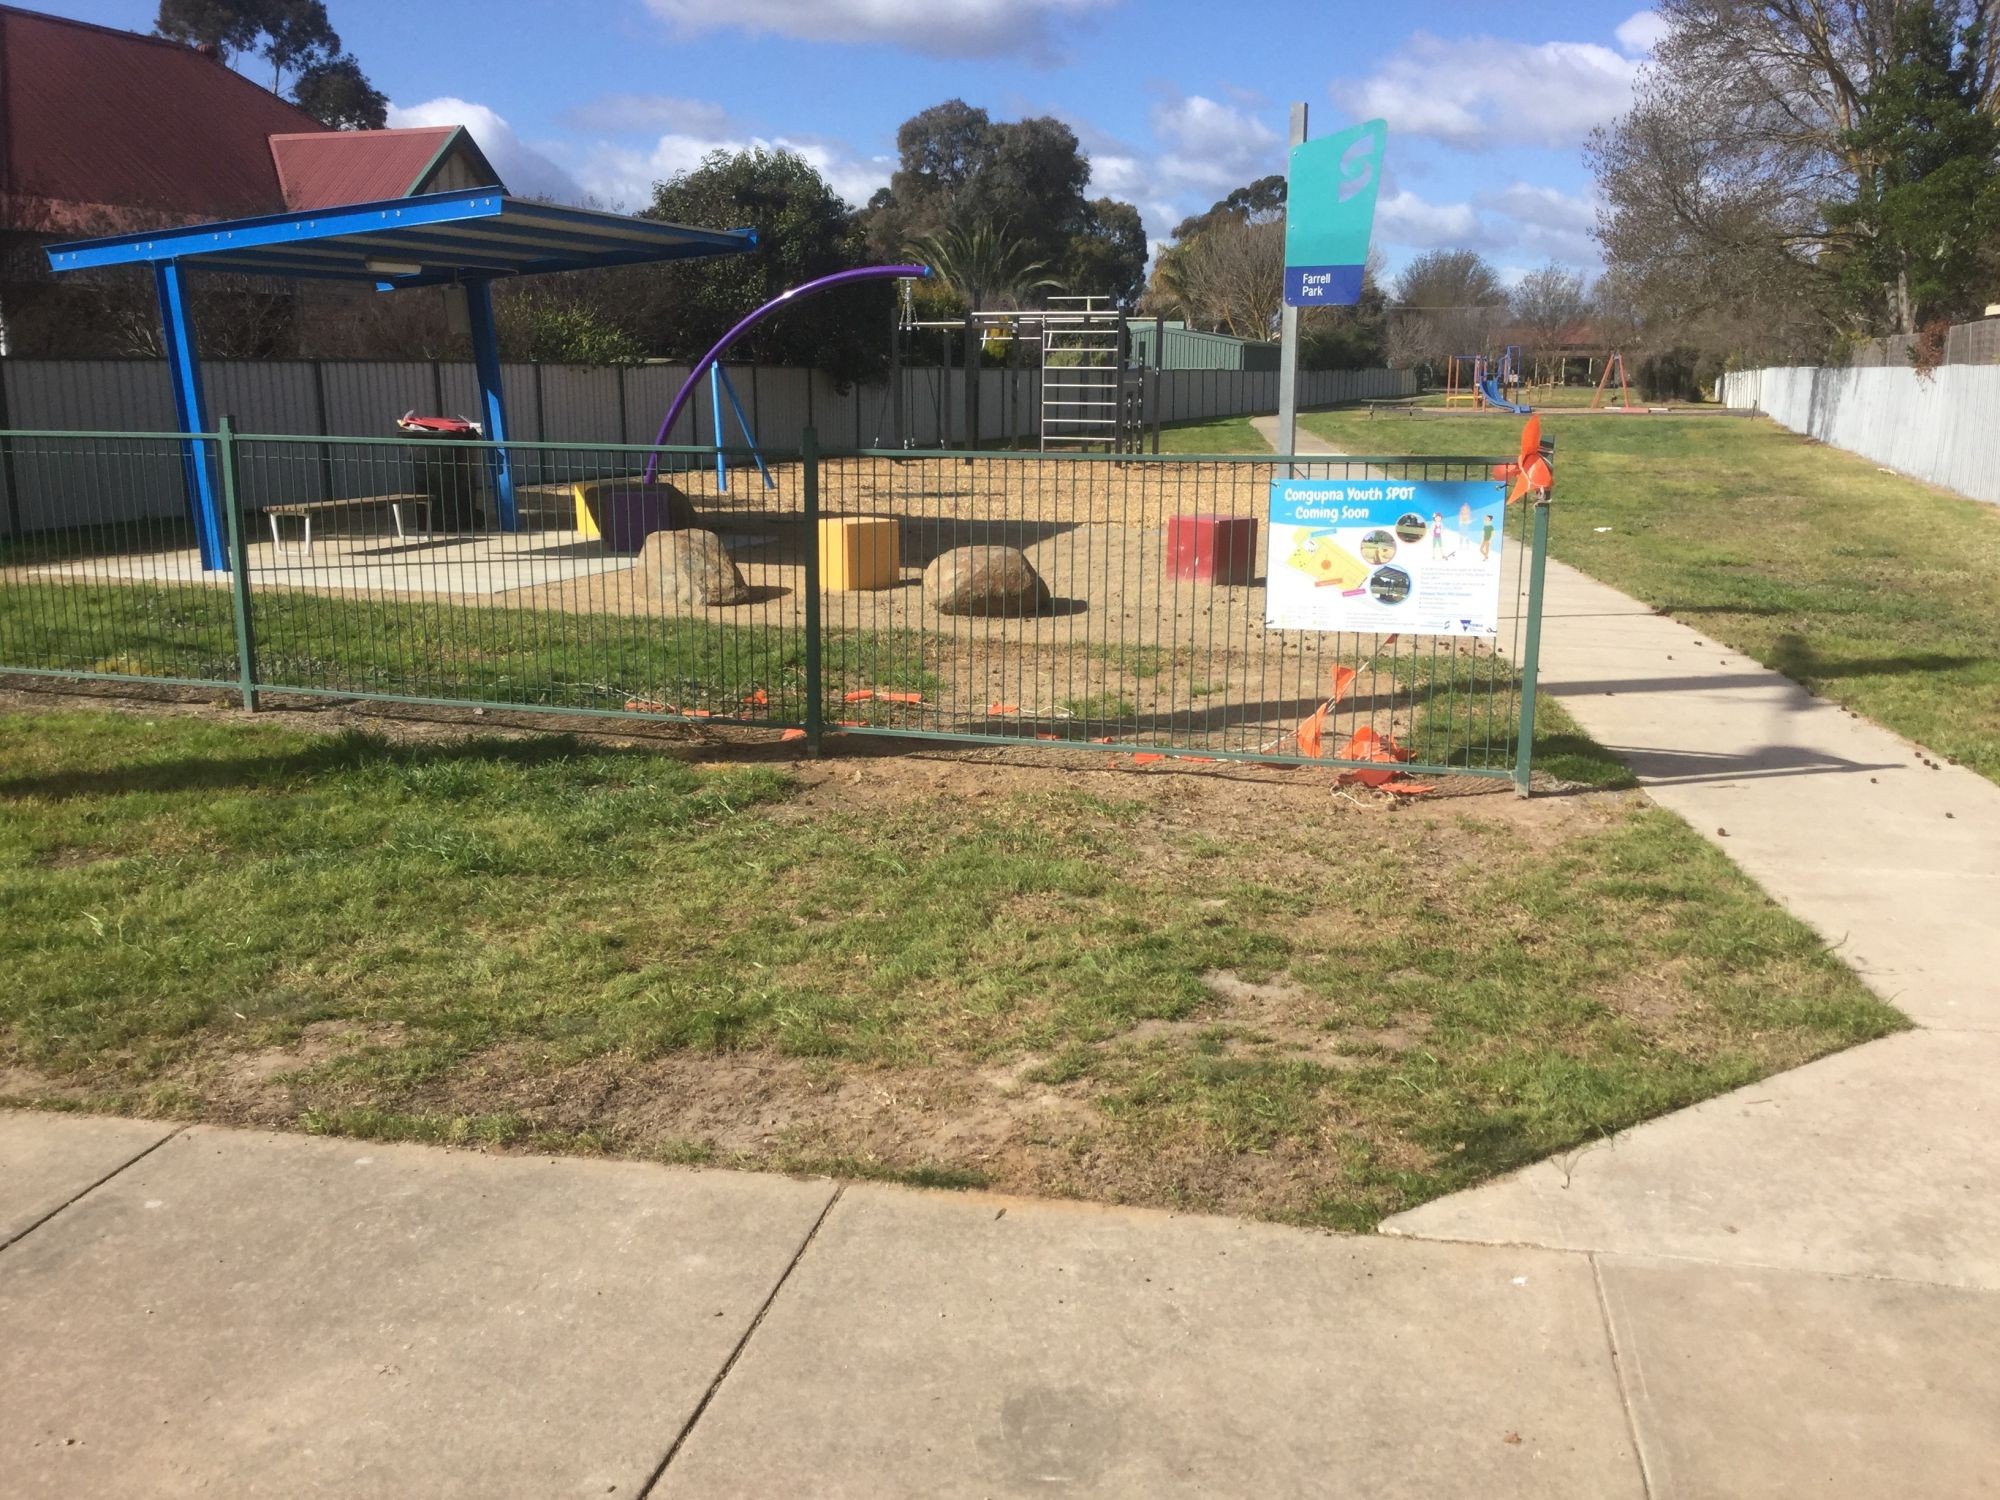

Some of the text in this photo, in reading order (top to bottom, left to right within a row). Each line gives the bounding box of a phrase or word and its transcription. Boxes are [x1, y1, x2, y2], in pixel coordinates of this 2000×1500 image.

[1303, 273, 1331, 284] Farrell
[1302, 286, 1323, 297] Park
[1284, 487, 1416, 505] Congupna Youth SPOT
[1295, 506, 1338, 523] Coming
[1342, 506, 1369, 519] Soon
